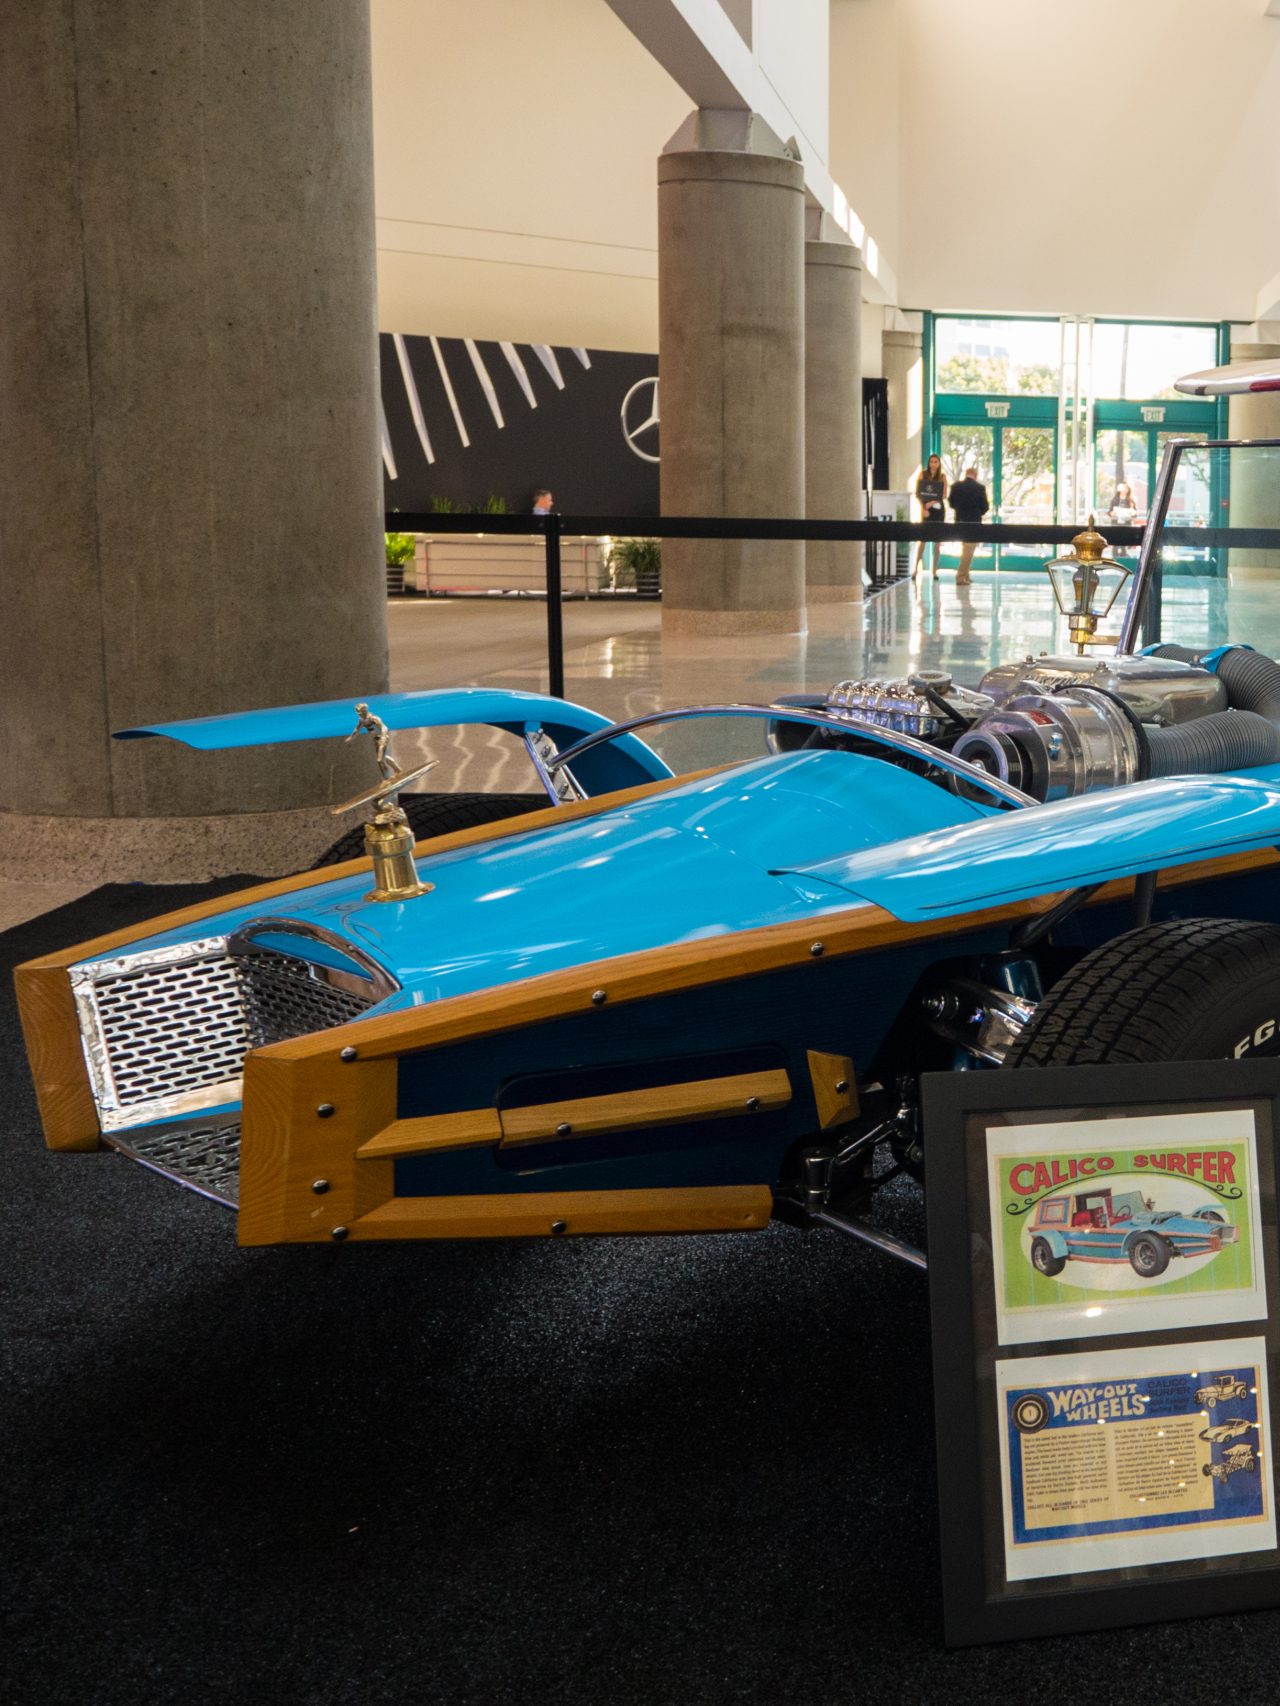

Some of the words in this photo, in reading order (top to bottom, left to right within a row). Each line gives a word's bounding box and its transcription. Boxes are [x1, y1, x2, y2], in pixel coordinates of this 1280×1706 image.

[989, 406, 1006, 417] EXIT
[1146, 411, 1161, 422] EXIT
[1009, 1156, 1114, 1196] CALICO
[1133, 1151, 1236, 1184] SURFER
[1046, 1383, 1138, 1417] WAY-OUT
[1066, 1394, 1145, 1422] WHEELS
